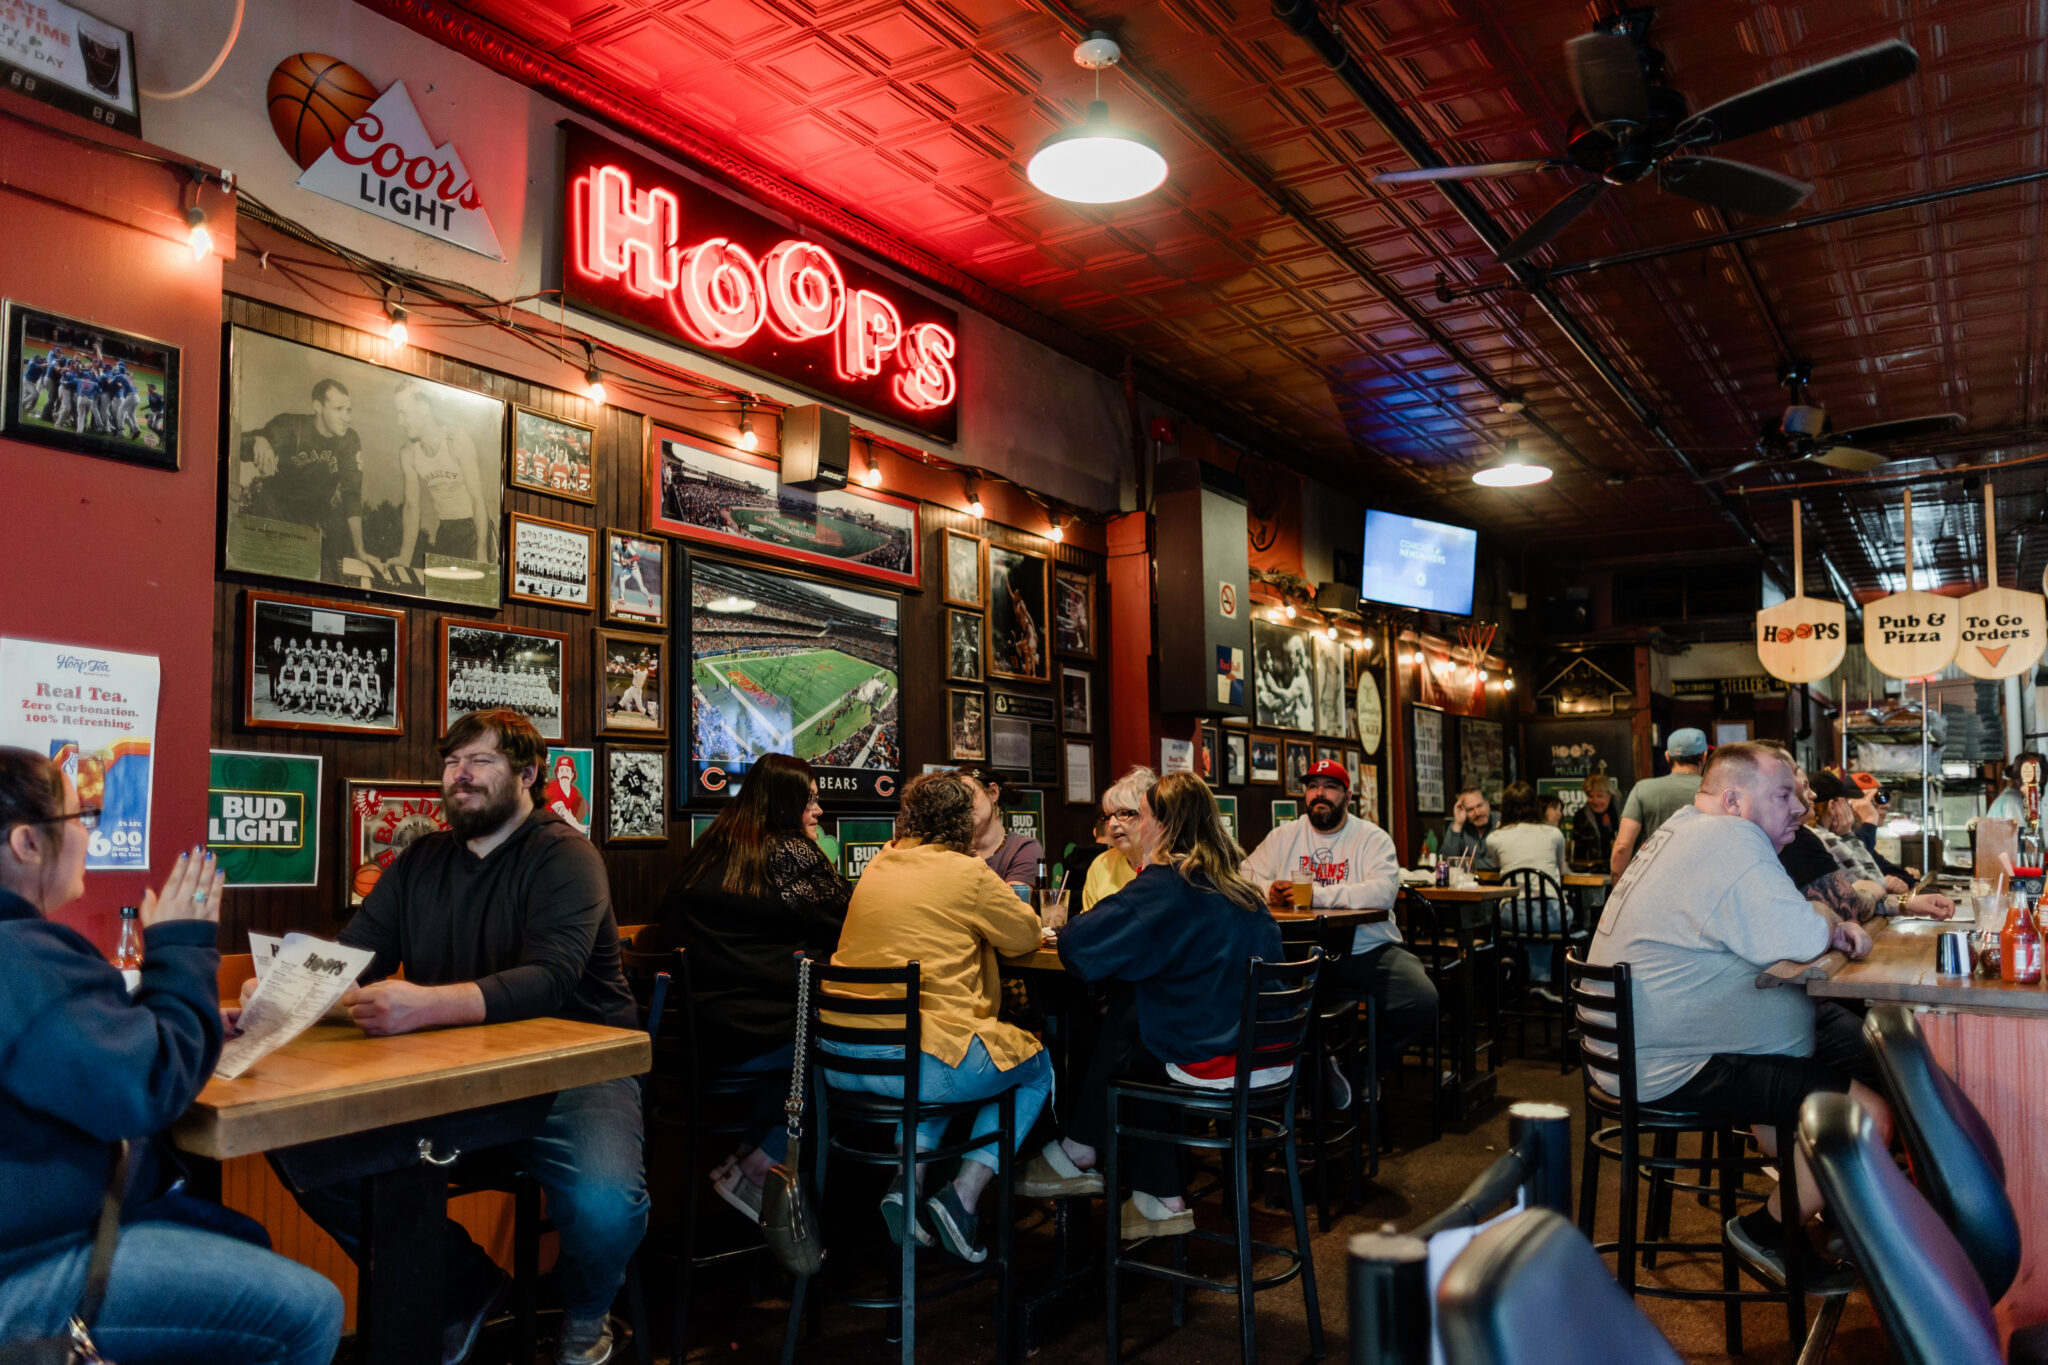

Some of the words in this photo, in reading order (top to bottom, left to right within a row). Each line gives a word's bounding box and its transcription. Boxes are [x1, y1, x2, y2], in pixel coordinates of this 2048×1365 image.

[24, 15, 71, 48] TIME
[34, 50, 64, 68] DAY
[331, 112, 483, 211] Coors
[360, 171, 456, 231] LIGHT
[1878, 615, 1920, 630] Pub
[1926, 612, 1946, 627] &
[1966, 616, 1990, 629] To
[1995, 613, 2023, 627] Go
[1884, 630, 1941, 644] Pizza
[1962, 628, 2030, 643] Orders
[36, 682, 82, 699] Real
[88, 686, 128, 704] Tea.
[22, 699, 52, 711] Zero
[56, 702, 139, 718] Carbonation.
[25, 713, 58, 724] 100%
[62, 715, 134, 731] Refreshing.
[1317, 760, 1329, 773] P
[629, 774, 641, 788] 16
[820, 776, 858, 790] BEARS
[222, 796, 287, 819] BUD
[375, 798, 453, 844] BRADLE
[1011, 814, 1034, 828] BUD
[1301, 856, 1346, 881] PLAINS
